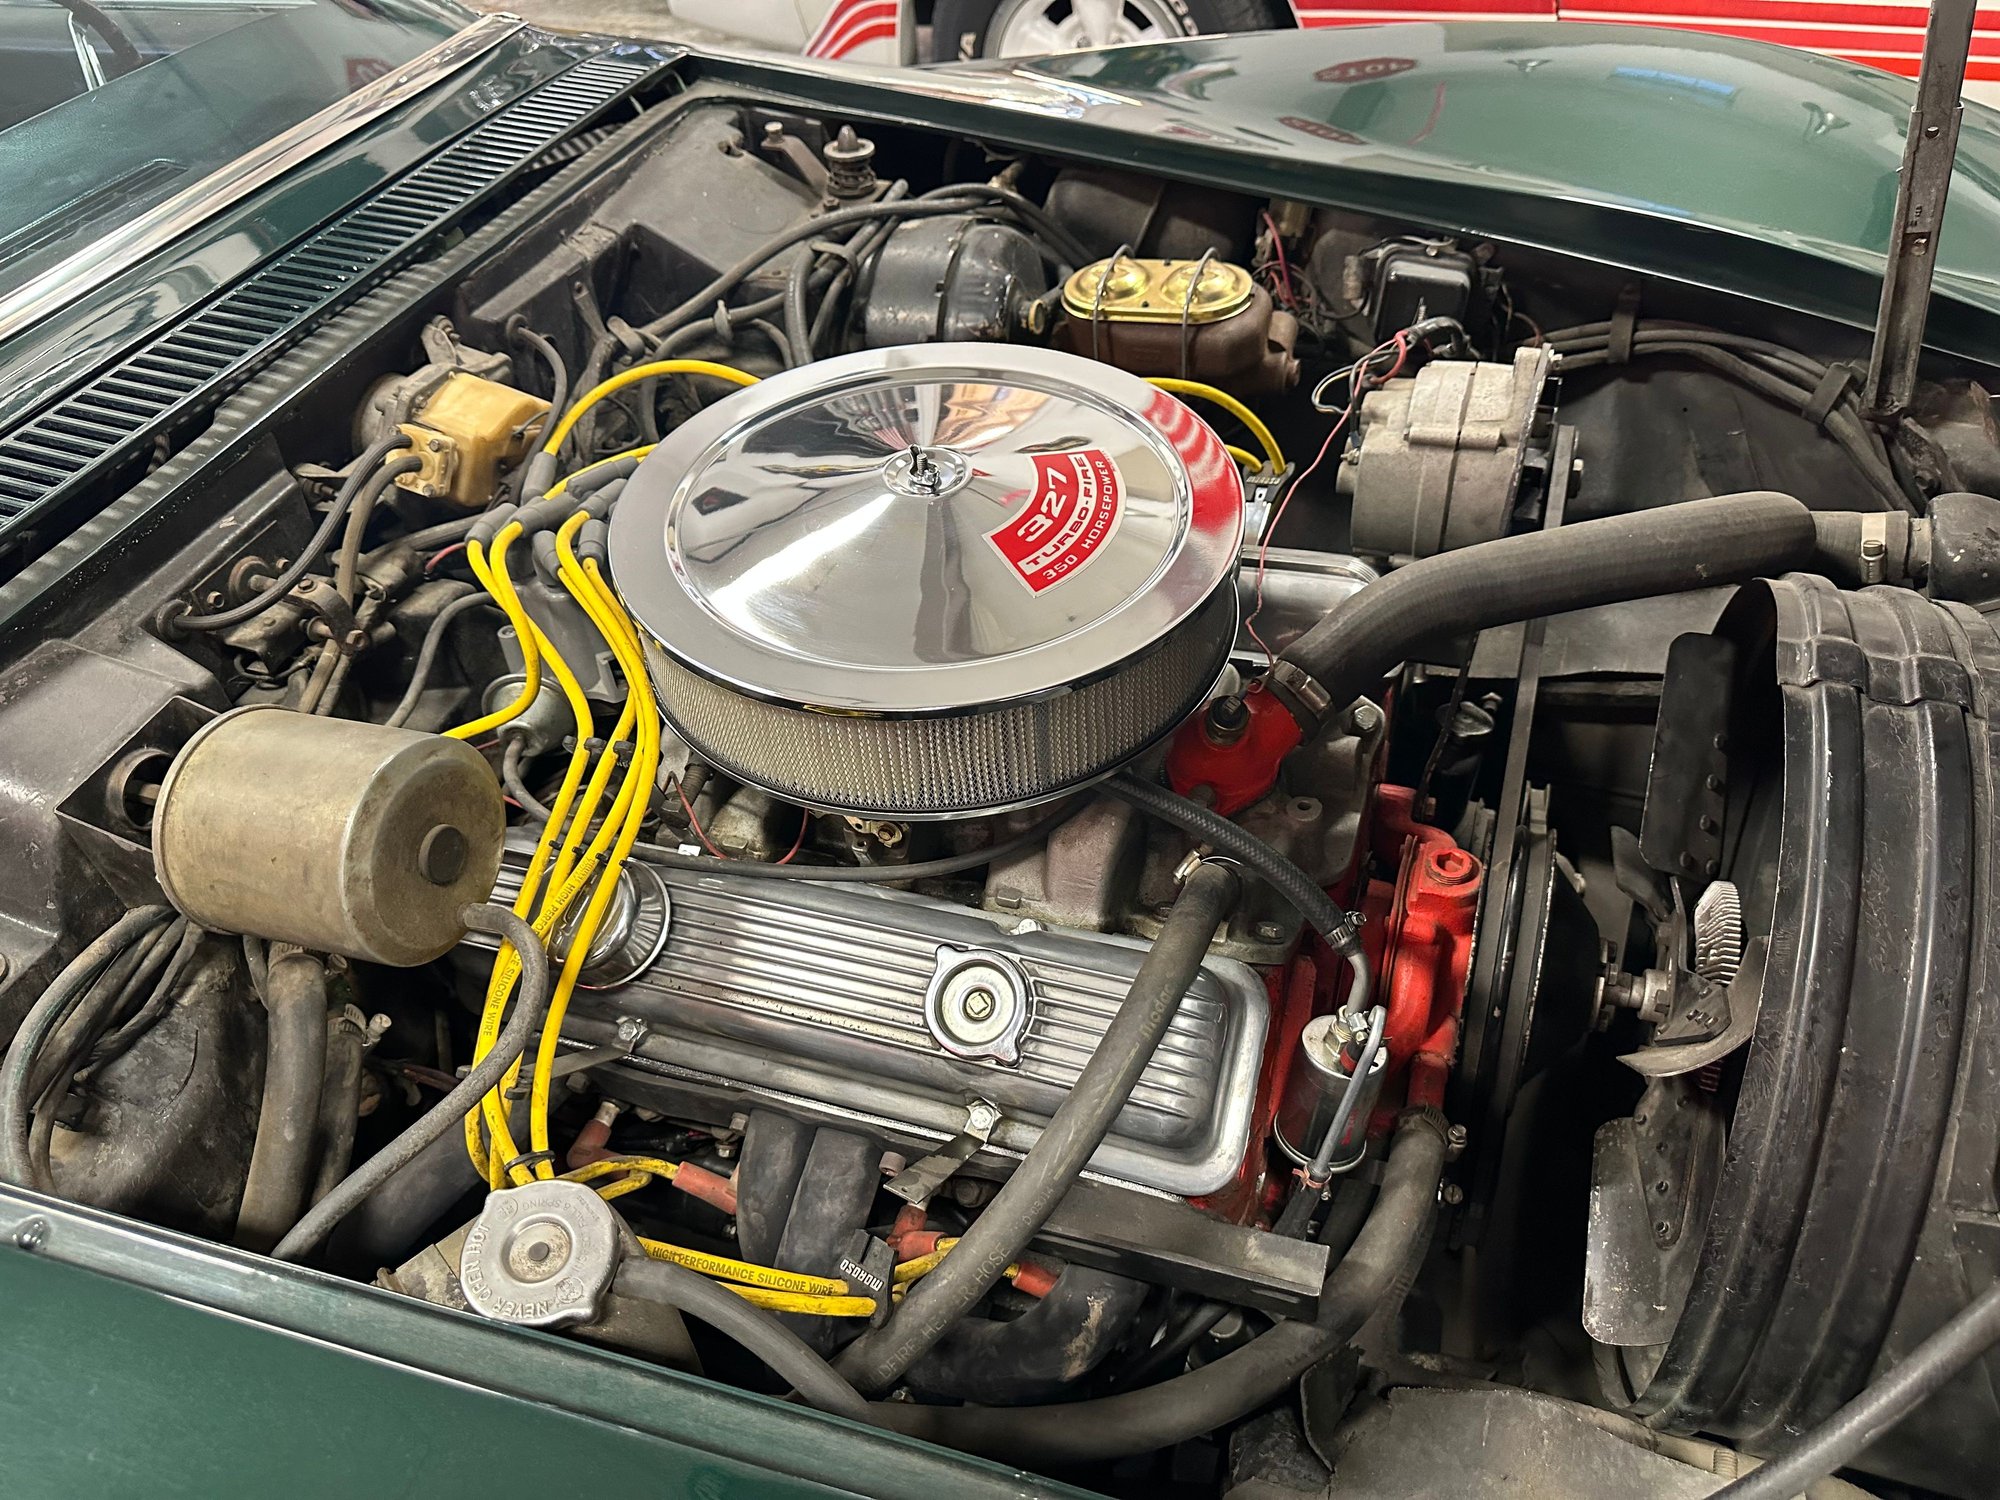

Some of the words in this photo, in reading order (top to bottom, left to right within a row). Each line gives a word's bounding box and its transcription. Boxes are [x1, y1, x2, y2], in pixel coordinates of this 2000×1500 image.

[1017, 466, 1068, 543] 327
[1025, 456, 1093, 566] TURBO-FIRE
[1042, 554, 1078, 580] 350
[1081, 460, 1113, 550] HORSEPOWER
[558, 882, 576, 906] HIGH
[490, 965, 516, 1010] SILICONE
[483, 1010, 498, 1037] WIRE
[522, 1198, 562, 1211] SPRING
[468, 1222, 490, 1255] HOT
[464, 1260, 493, 1301] OPEN
[652, 1246, 676, 1263] HIGH
[678, 1253, 755, 1281] PERFORMANCE
[756, 1272, 806, 1292] SILICONE
[808, 1282, 834, 1297] WIRE
[839, 1258, 884, 1293] MOROSO
[921, 1285, 976, 1341] HER
[974, 1243, 1012, 1286] HOSE
[492, 1296, 550, 1319] NEVER
